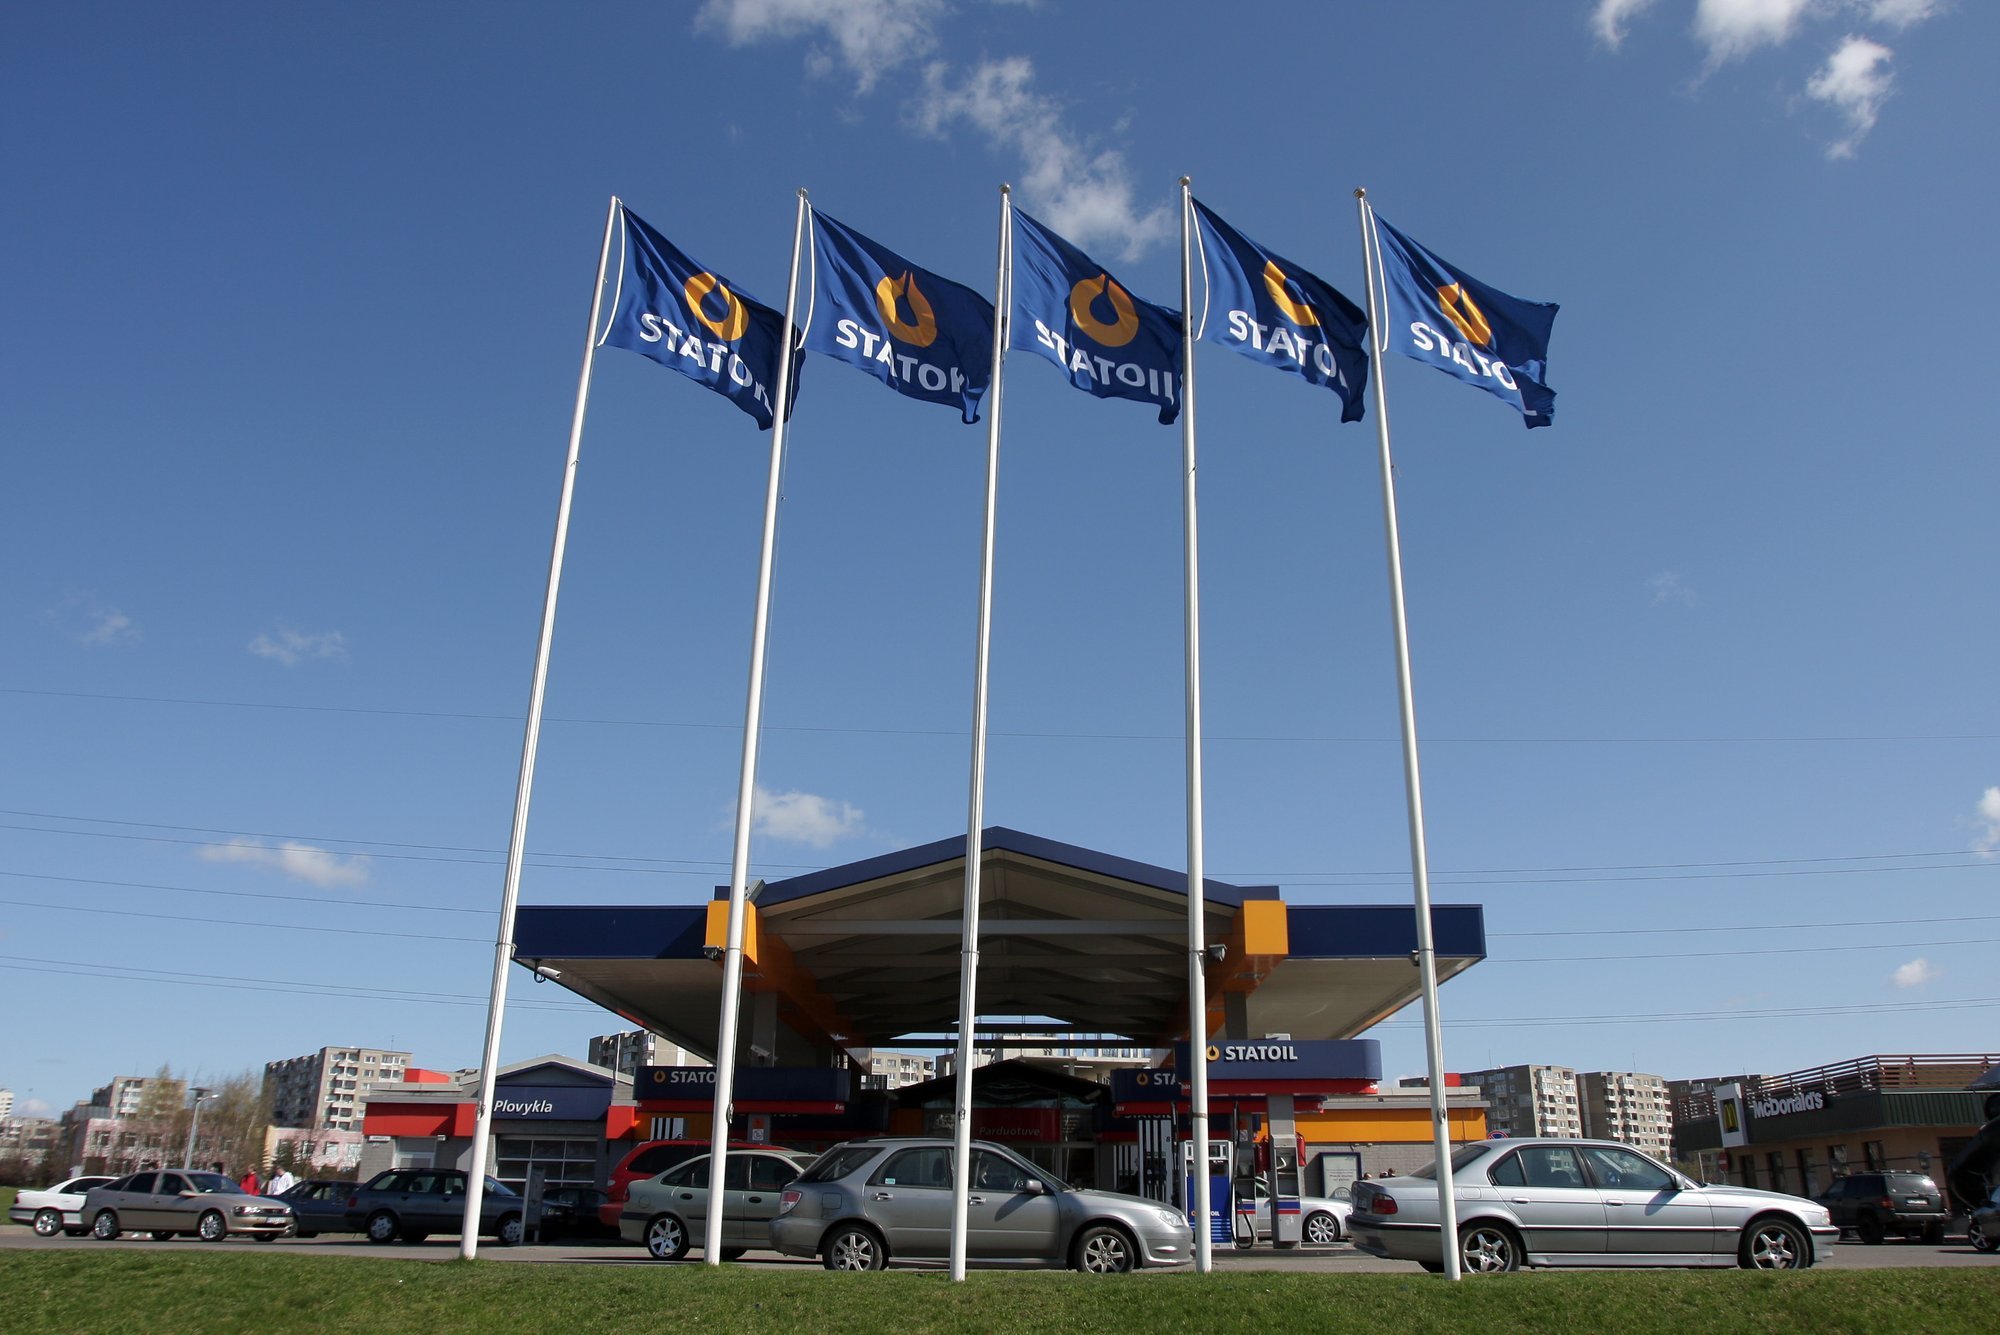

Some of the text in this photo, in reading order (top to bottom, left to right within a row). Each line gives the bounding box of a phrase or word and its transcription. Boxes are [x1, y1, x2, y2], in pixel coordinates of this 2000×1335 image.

[1228, 310, 1348, 389] STATO
[1225, 1045, 1298, 1061] STATOIL
[670, 1071, 717, 1084] STATO
[493, 1099, 553, 1116] Plovykla
[1753, 1091, 1824, 1119] McDonald's
